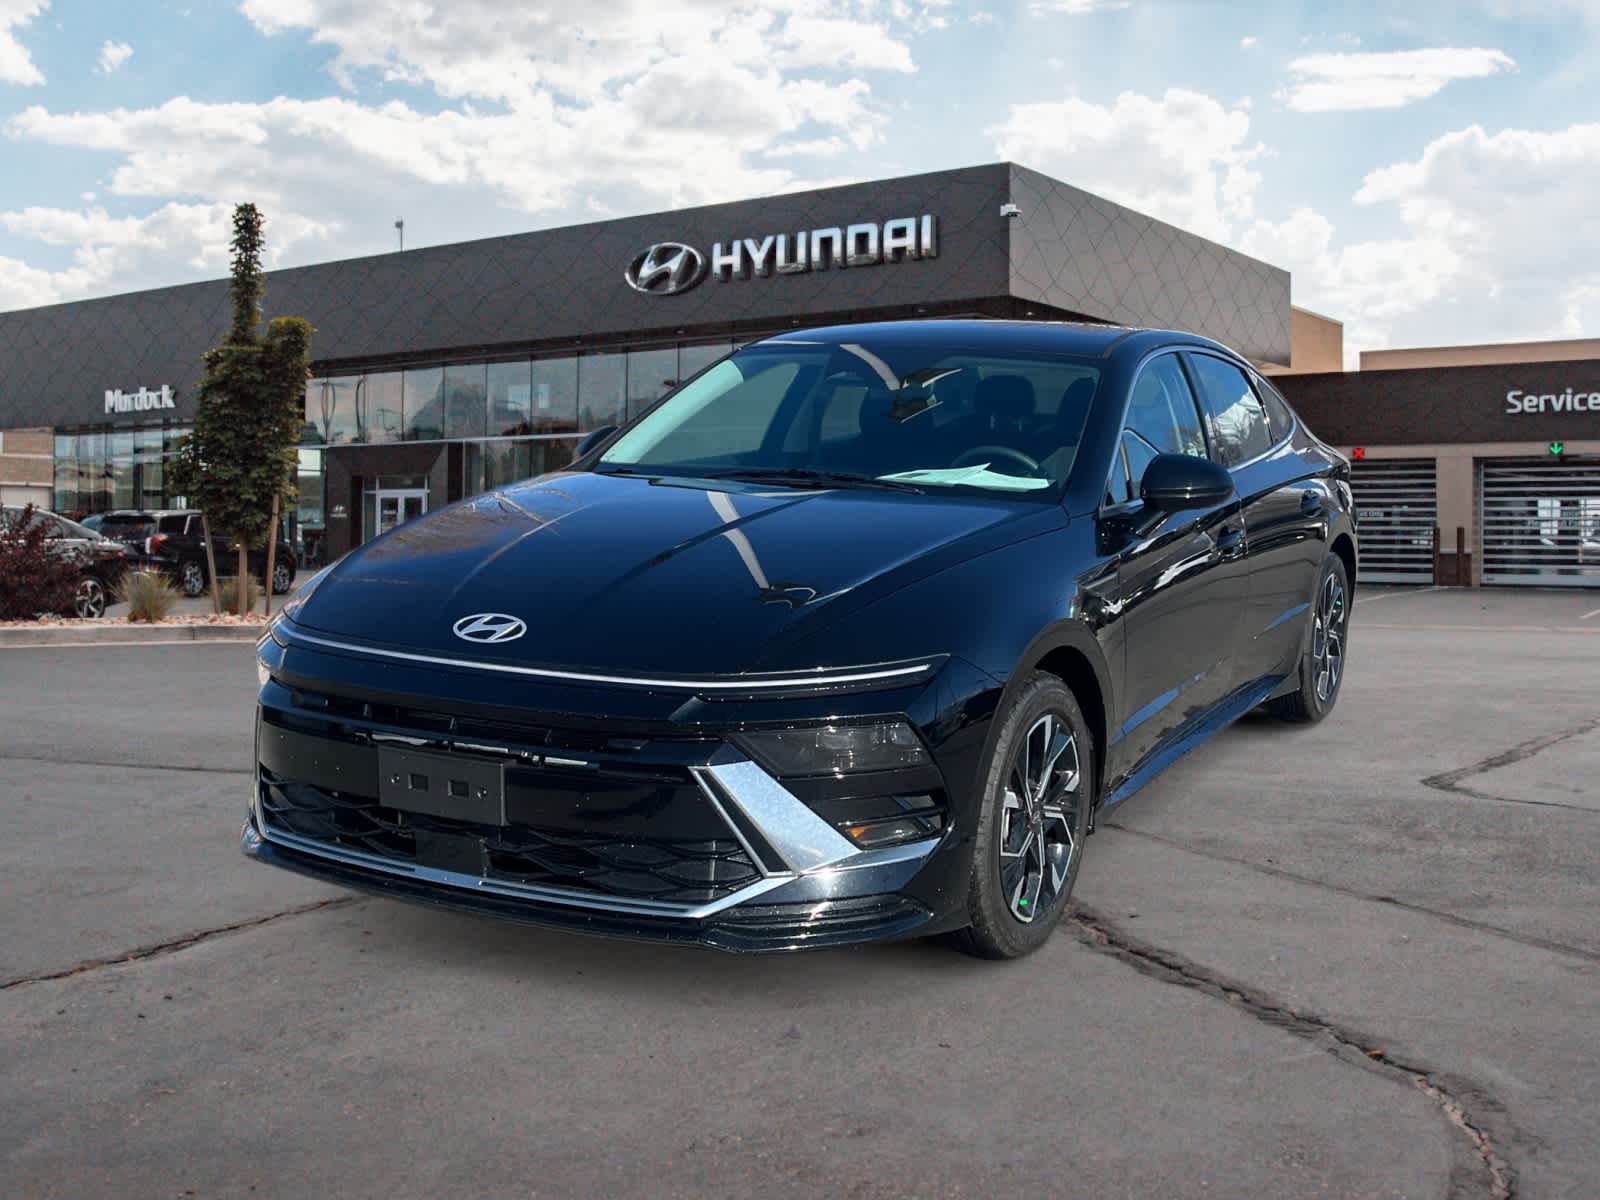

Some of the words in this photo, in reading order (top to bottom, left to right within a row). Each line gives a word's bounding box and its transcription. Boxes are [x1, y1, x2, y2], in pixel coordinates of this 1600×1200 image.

[712, 214, 934, 281] HYUNDAI
[104, 384, 176, 414] Murdock
[1505, 387, 1600, 414] Service
